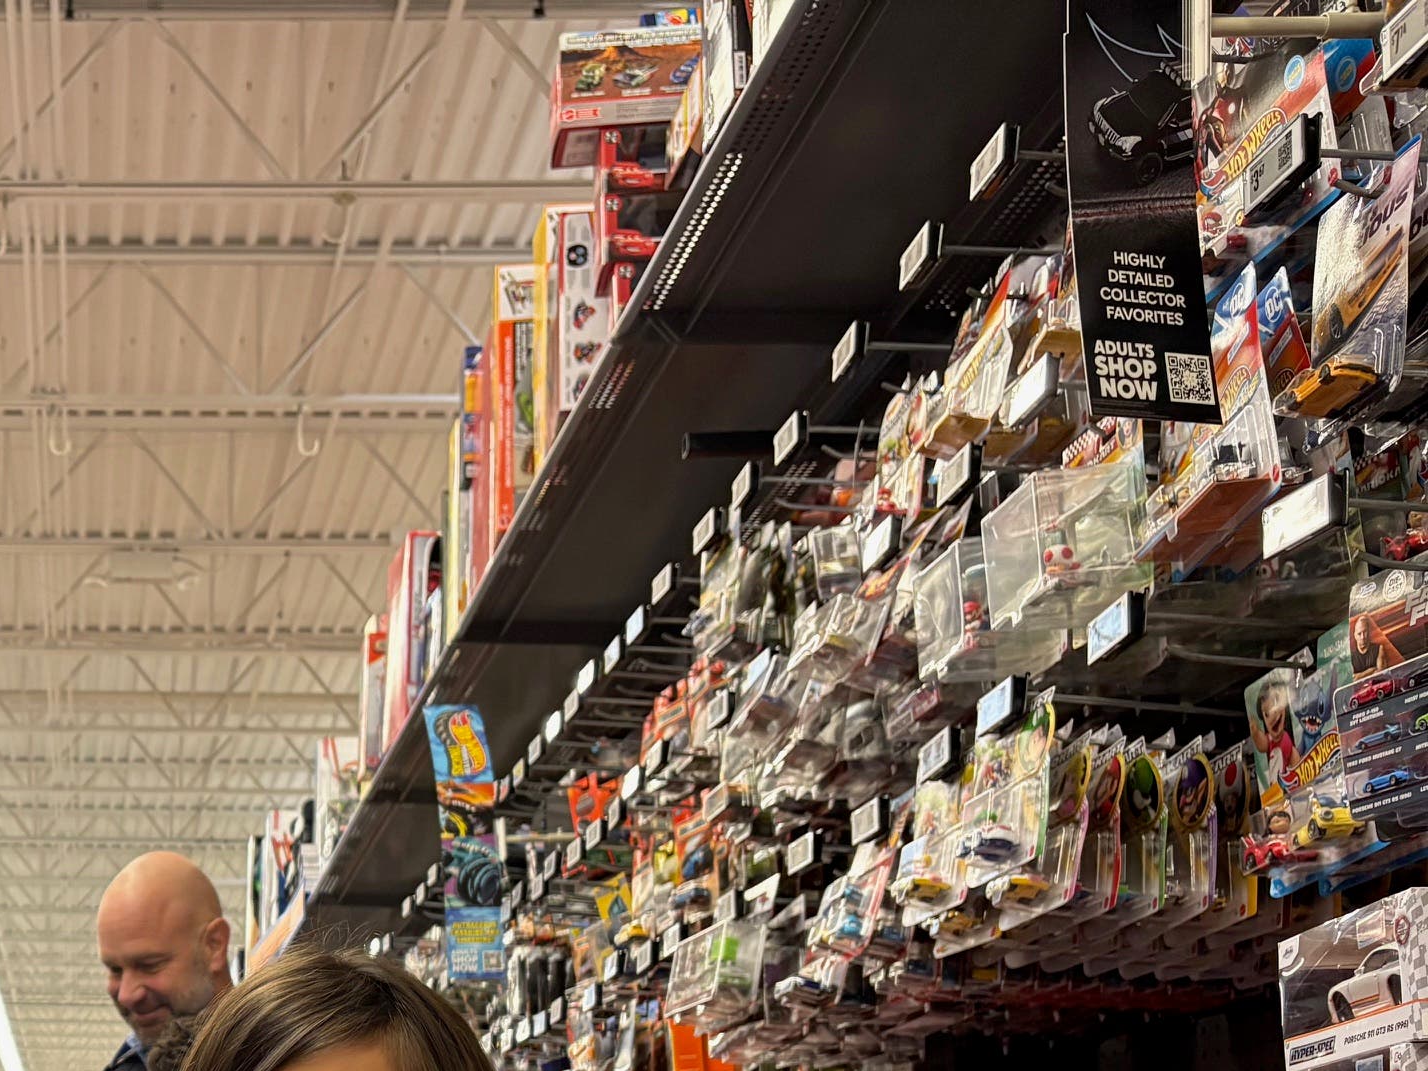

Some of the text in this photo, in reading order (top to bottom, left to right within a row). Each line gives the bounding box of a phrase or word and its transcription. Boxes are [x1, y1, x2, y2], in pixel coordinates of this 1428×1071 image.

[1113, 251, 1166, 269] HIGHLY
[1108, 269, 1174, 288] DETAILED
[1100, 287, 1187, 308] COLLECTOR
[1106, 306, 1184, 326] FAVORITES
[1094, 340, 1155, 358] ADULTS
[1094, 355, 1157, 379] SHOP
[1099, 376, 1158, 401] NOW
[1298, 762, 1316, 785] HOT
[452, 964, 478, 973] NOW
[1344, 1032, 1366, 1045] PORSCHE
[1367, 1029, 1376, 1038] 911
[1376, 1027, 1385, 1036] GT3
[1386, 1025, 1394, 1034] RS
[1290, 1038, 1335, 1062] HYPER-SPEC
